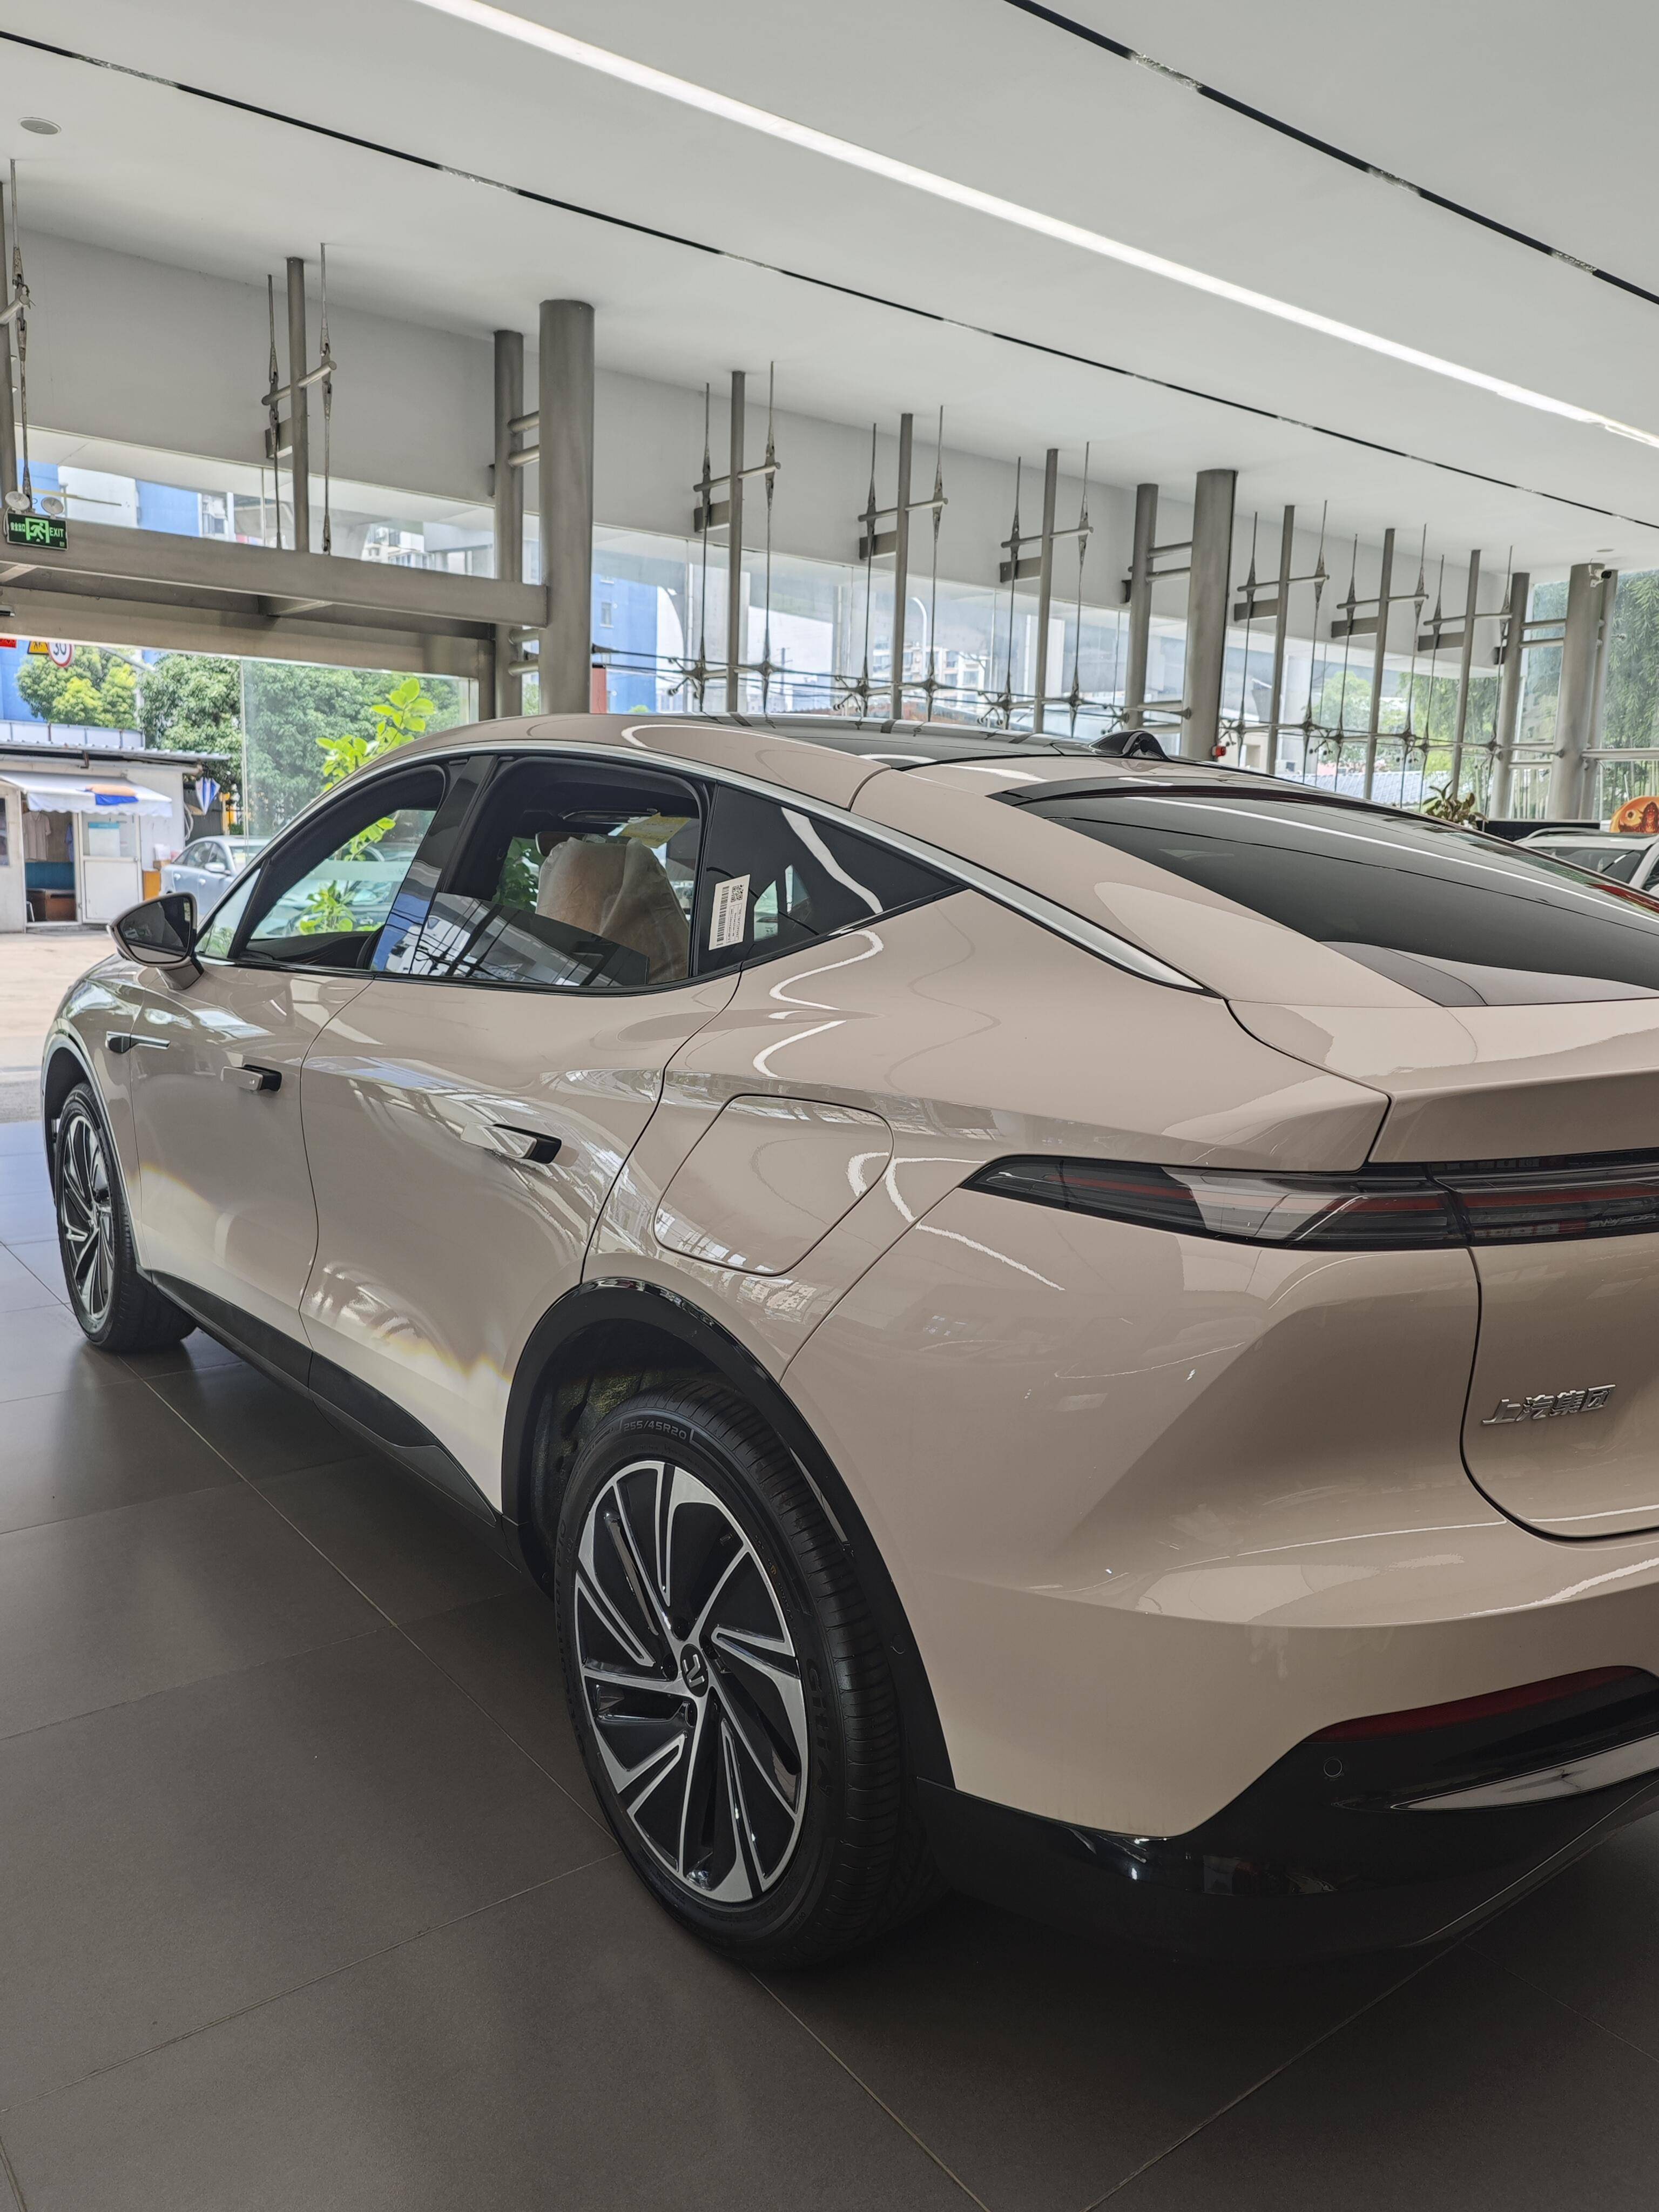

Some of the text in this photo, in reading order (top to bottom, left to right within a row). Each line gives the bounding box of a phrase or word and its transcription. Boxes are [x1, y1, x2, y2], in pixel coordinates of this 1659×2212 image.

[50, 527, 64, 537] EXIT
[1482, 1384, 1616, 1425] 上汽集团
[624, 1420, 687, 1440] 255/45R20
[807, 1658, 831, 1751] Giti
